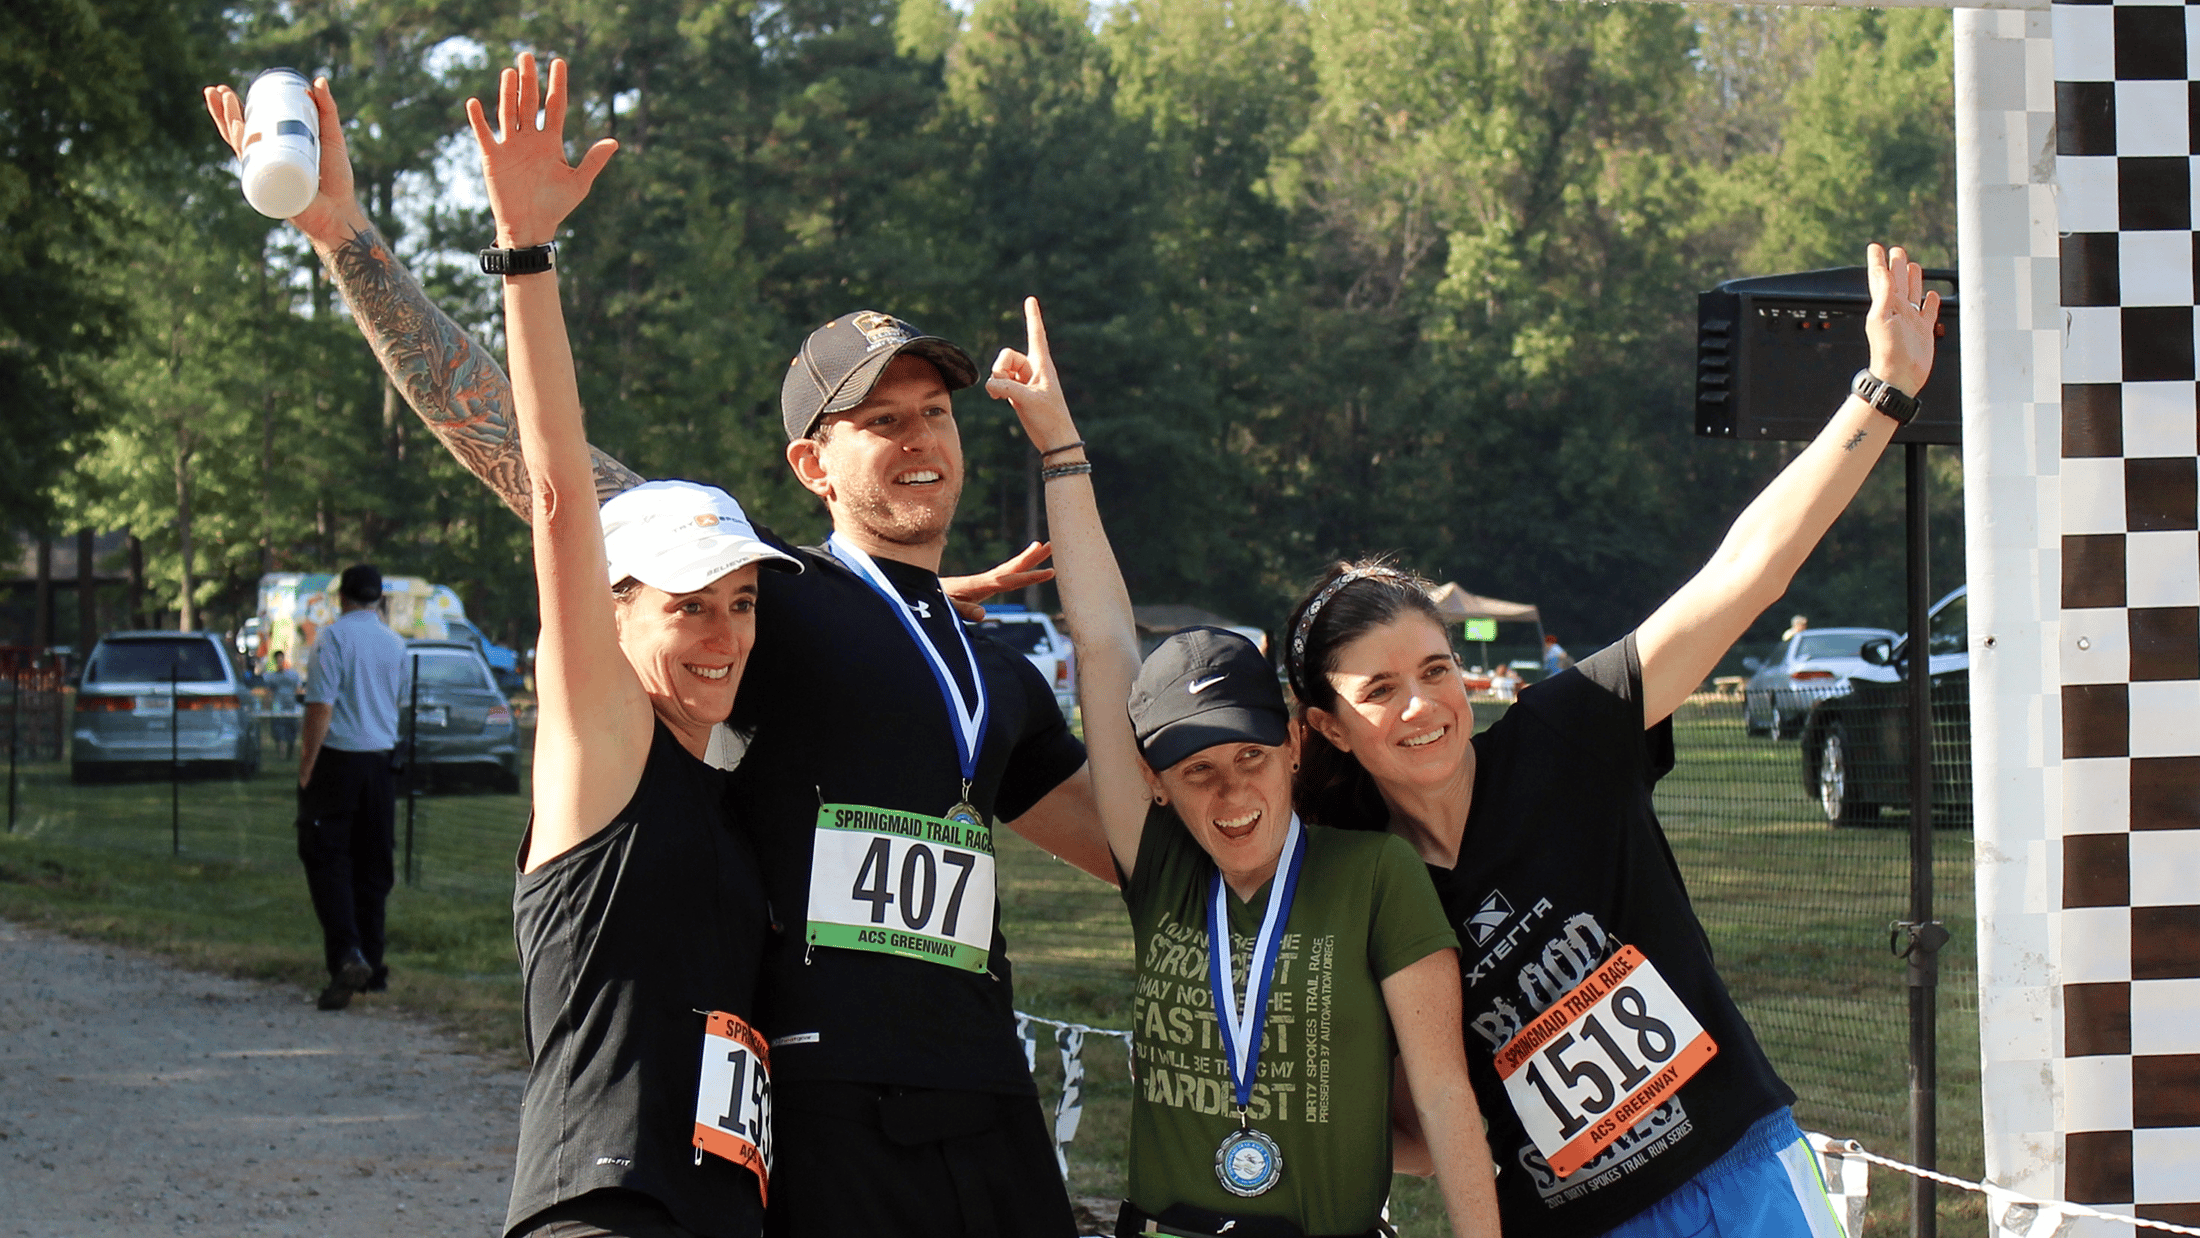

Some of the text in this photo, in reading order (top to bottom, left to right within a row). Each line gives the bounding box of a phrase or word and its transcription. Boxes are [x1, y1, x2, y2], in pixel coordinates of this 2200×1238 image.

[834, 809, 993, 853] SPRINGMAID TRAIL RACE
[852, 836, 976, 938] 407
[857, 929, 957, 959] ACS GREENWAY
[1323, 935, 1334, 969] DIRECT
[1465, 897, 1553, 988] XTERRA
[1139, 975, 1172, 999] MAY
[1321, 971, 1332, 1041] AUTOMATION
[1505, 956, 1634, 1068] SPRINGMAID TRAIL RACE
[1158, 1048, 1190, 1070] WILL
[1193, 1055, 1210, 1073] BE
[1271, 1061, 1294, 1078] MY
[1306, 938, 1324, 1122] DIRTY SPOKES TRAIL RACE
[1525, 986, 1676, 1141] 1518
[1143, 1066, 1296, 1120] HARDEST
[1319, 1059, 1330, 1123] PRESENTED
[1590, 1065, 1679, 1143] ACS GREENWAY
[1563, 1183, 1589, 1201] DIRTY
[1587, 1166, 1622, 1192] SPOKES
[1620, 1154, 1650, 1175] TRAIL
[1647, 1139, 1670, 1159] RUN
[1666, 1119, 1694, 1146] SERIES
